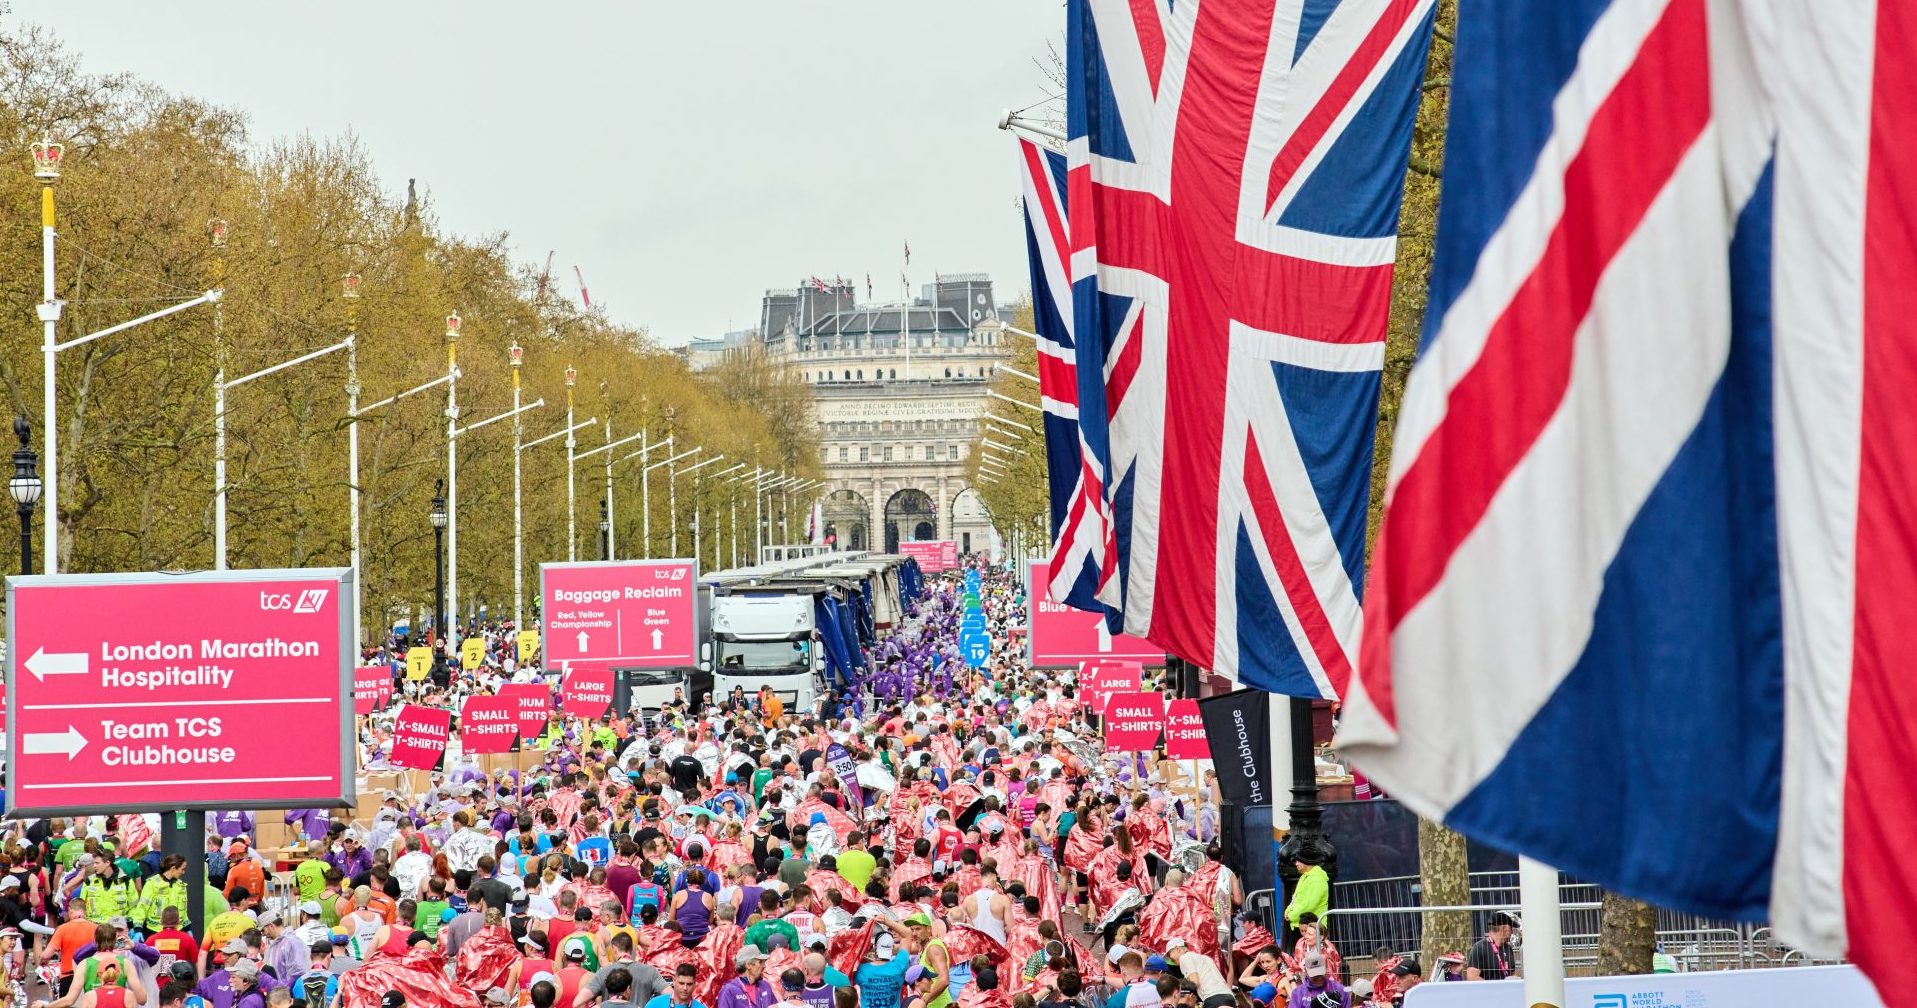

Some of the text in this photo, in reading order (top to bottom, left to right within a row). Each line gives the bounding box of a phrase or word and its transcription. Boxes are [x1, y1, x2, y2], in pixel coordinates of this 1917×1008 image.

[260, 590, 292, 610] tcs
[555, 586, 682, 604] Baggage Reclaim
[647, 608, 666, 616] Blue
[1039, 602, 1068, 612] Blue
[557, 612, 576, 620] Red,
[550, 620, 612, 629] Championship
[644, 618, 670, 626] Green
[102, 638, 320, 661] London Marathon
[971, 649, 985, 659] 19
[471, 652, 477, 661] 2
[416, 662, 421, 671] 1
[102, 666, 234, 690] Hospitality
[354, 680, 376, 689] ARGE
[574, 682, 605, 691] LARGE
[1101, 680, 1132, 688] LARGE
[566, 692, 611, 703] T-SHIRTS
[472, 710, 509, 720] SMALL
[1115, 708, 1154, 718] SMALL
[101, 717, 222, 739] Team TCS
[398, 720, 446, 736] X-SMALL
[464, 724, 518, 734] T-SHIRTS
[1108, 722, 1162, 732] T-SHIRTS
[1168, 729, 1206, 740] T-SHIR
[396, 735, 444, 750] T-SHIRTS
[101, 745, 236, 766] Clubhouse
[1233, 709, 1262, 803] the Clubhouse
[836, 761, 852, 774] 3:50
